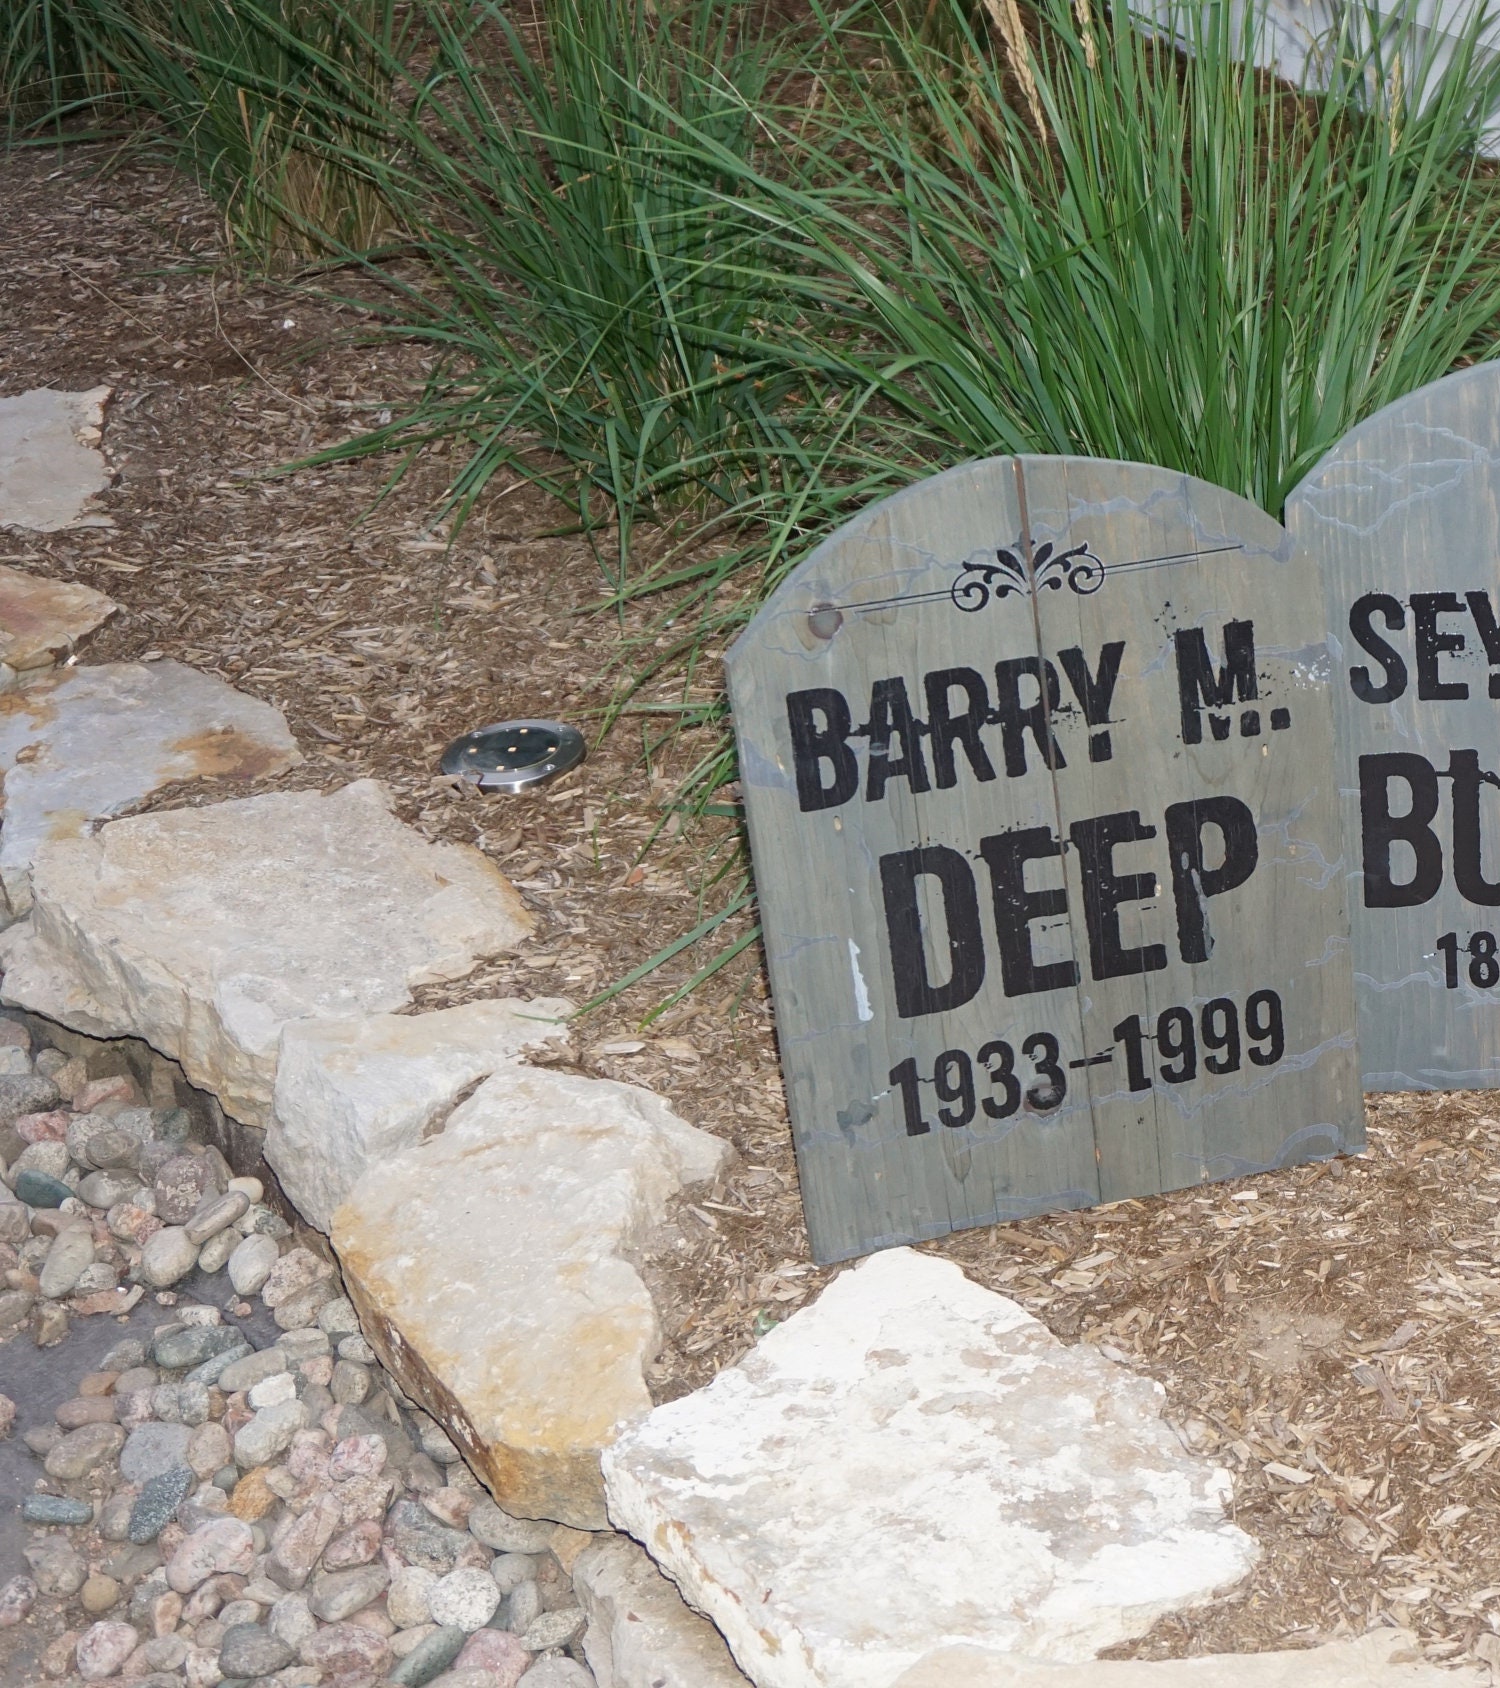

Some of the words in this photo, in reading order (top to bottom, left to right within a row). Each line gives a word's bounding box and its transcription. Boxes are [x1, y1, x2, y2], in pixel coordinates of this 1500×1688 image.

[786, 640, 1125, 812] BARRY
[1176, 620, 1290, 745] M.
[878, 795, 1258, 1018] DEEP
[888, 988, 1285, 1137] 1933-1999
